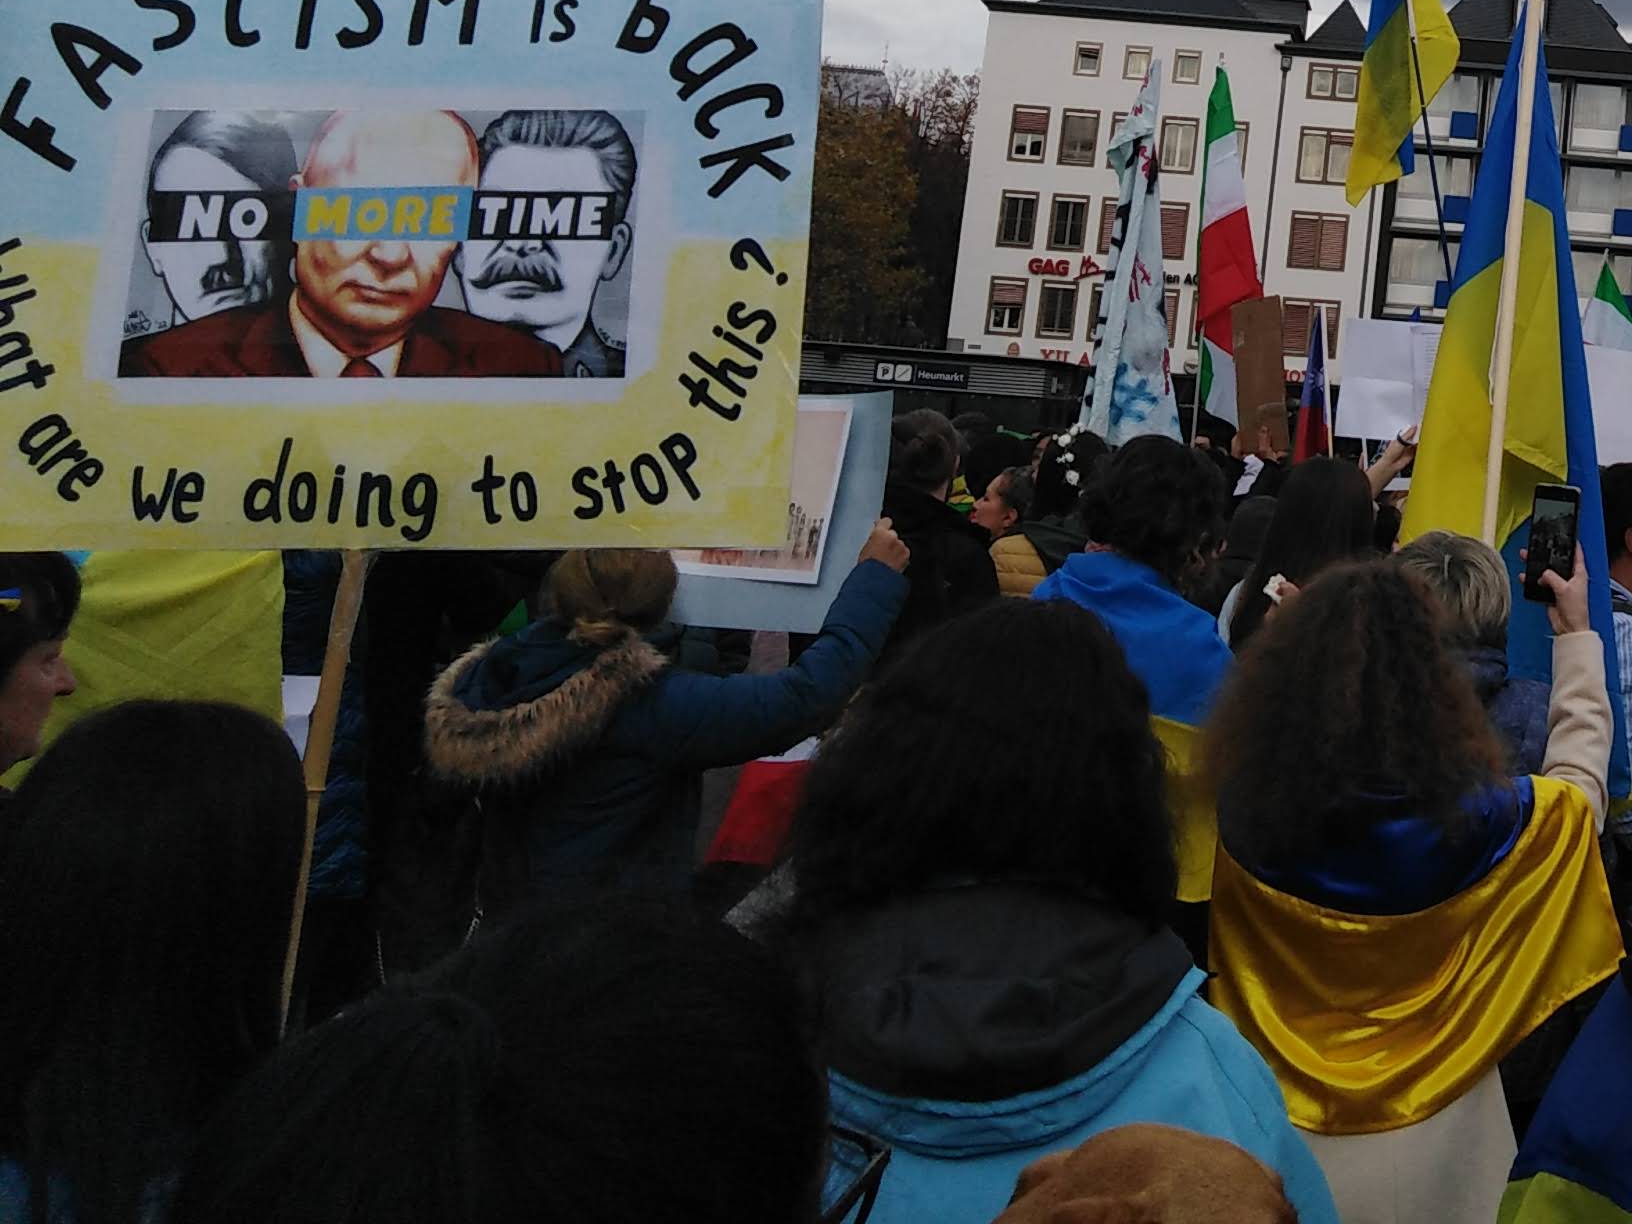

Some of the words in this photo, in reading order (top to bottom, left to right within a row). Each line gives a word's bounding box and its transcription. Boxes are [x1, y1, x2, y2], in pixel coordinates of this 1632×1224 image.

[178, 195, 270, 239] NO
[305, 194, 459, 235] MORE
[477, 196, 608, 237] TIME
[1028, 258, 1071, 276] GAG
[917, 370, 965, 382] Heumarkt
[18, 413, 104, 502] are
[243, 437, 438, 542] doing
[471, 455, 538, 525] to
